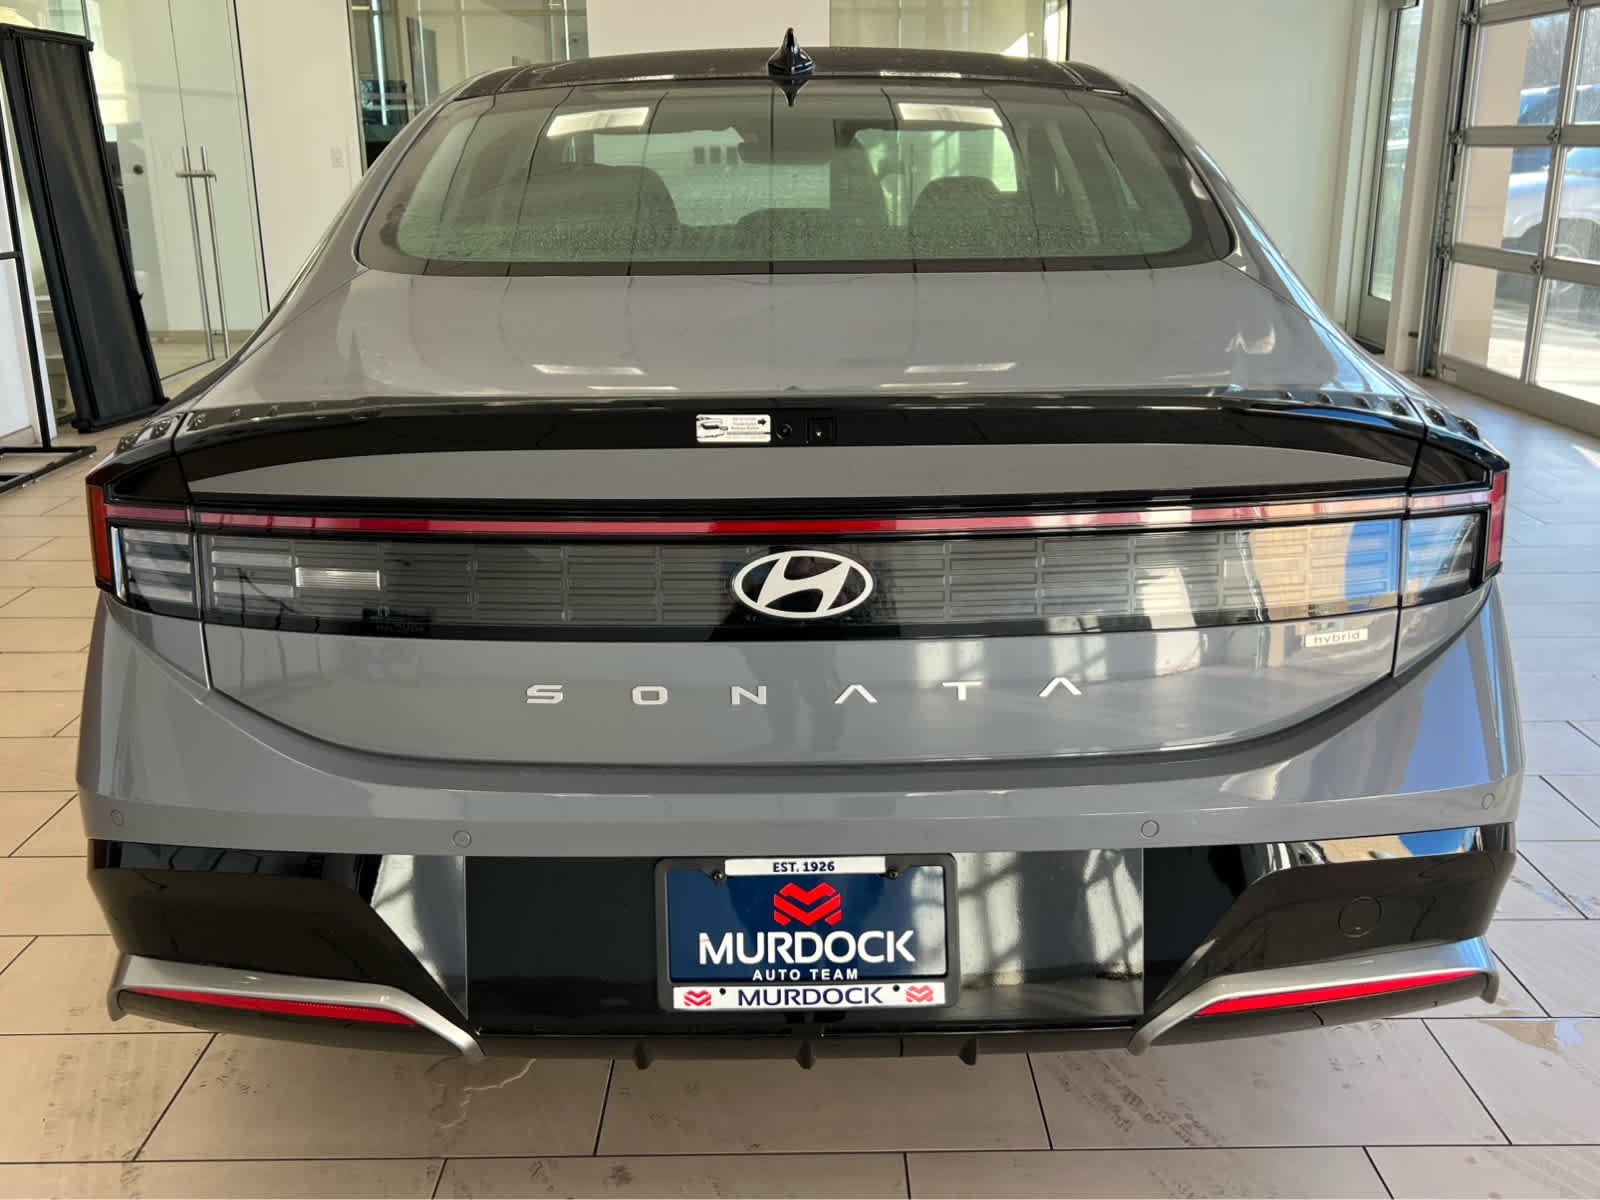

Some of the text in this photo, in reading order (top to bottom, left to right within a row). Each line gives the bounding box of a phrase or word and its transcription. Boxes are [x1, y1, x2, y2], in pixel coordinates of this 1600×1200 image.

[1314, 631, 1360, 645] hybrid
[526, 677, 1082, 705] SONATA
[772, 861, 835, 873] EST. 1926
[699, 930, 916, 965] MURDOCK
[752, 968, 859, 981] AUTO TEAM
[738, 987, 883, 1006] MURDOCK
